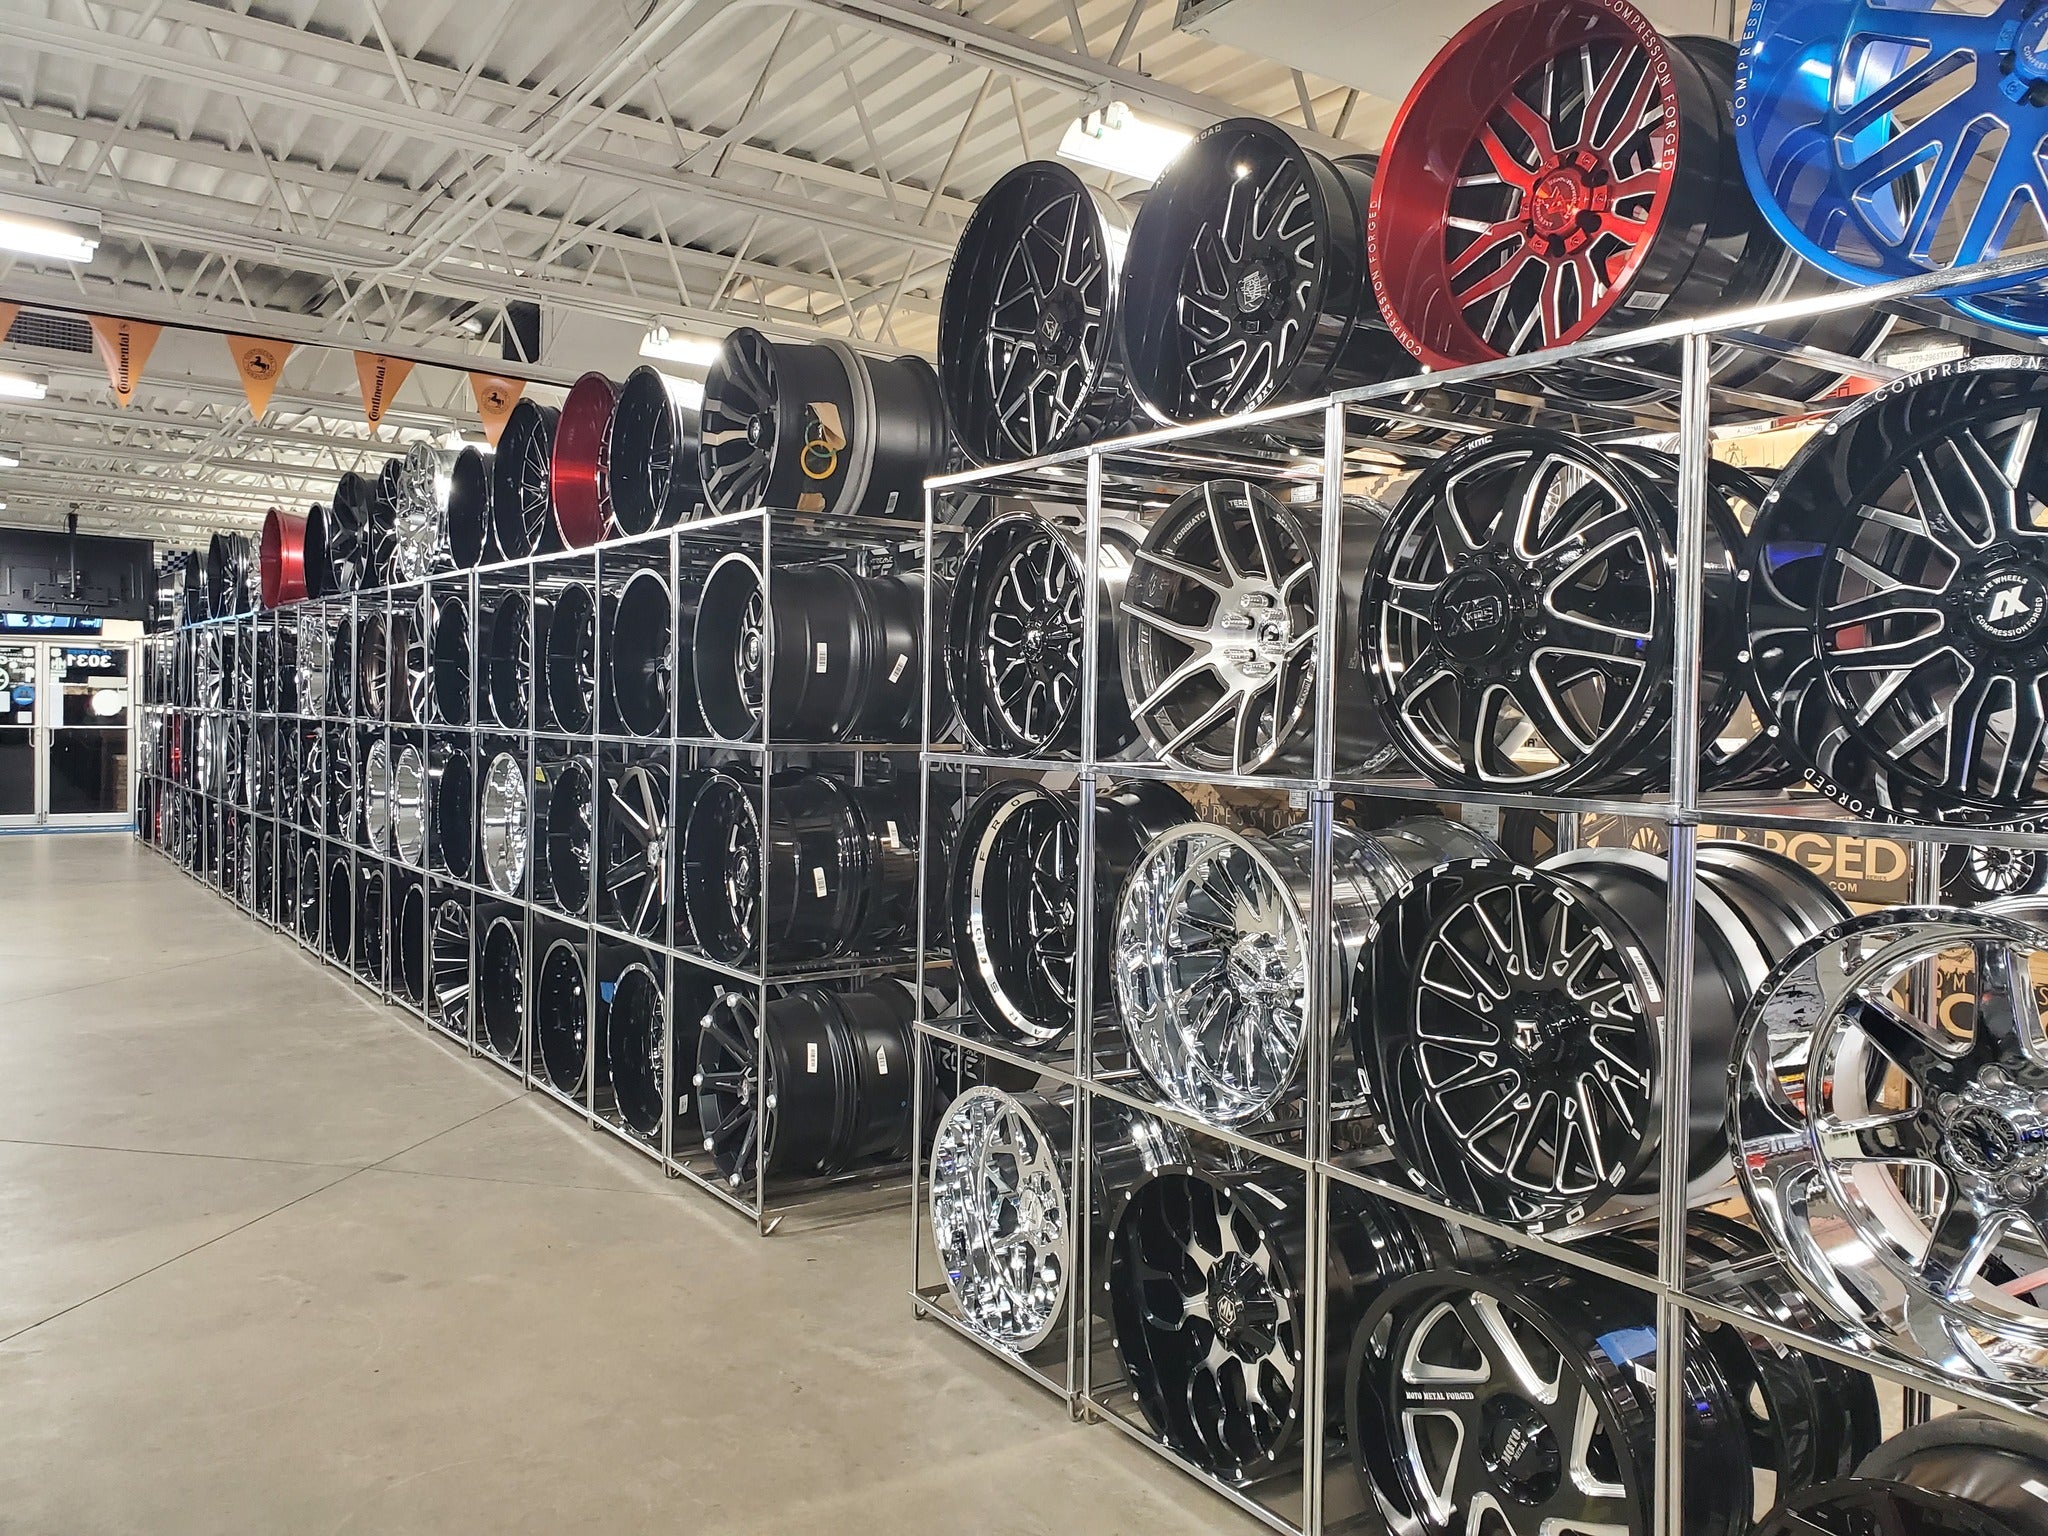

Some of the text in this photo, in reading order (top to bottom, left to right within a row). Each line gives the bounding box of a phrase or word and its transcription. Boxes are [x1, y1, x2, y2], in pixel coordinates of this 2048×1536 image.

[1604, 0, 1676, 171] COMPRESSION FORGED
[1367, 200, 1422, 357] COMPRESSION FORGED
[117, 332, 131, 395] Continental
[368, 365, 387, 422] Continental
[1172, 510, 1207, 545] FORGIATO
[1993, 574, 2029, 585] WHEELS
[1976, 614, 2029, 637] COMPRESSION
[1803, 766, 1877, 820] FORGED
[1423, 1391, 1446, 1400] METAL
[1446, 1391, 1475, 1400] FORGED
[1501, 1428, 1521, 1467] MOTO
